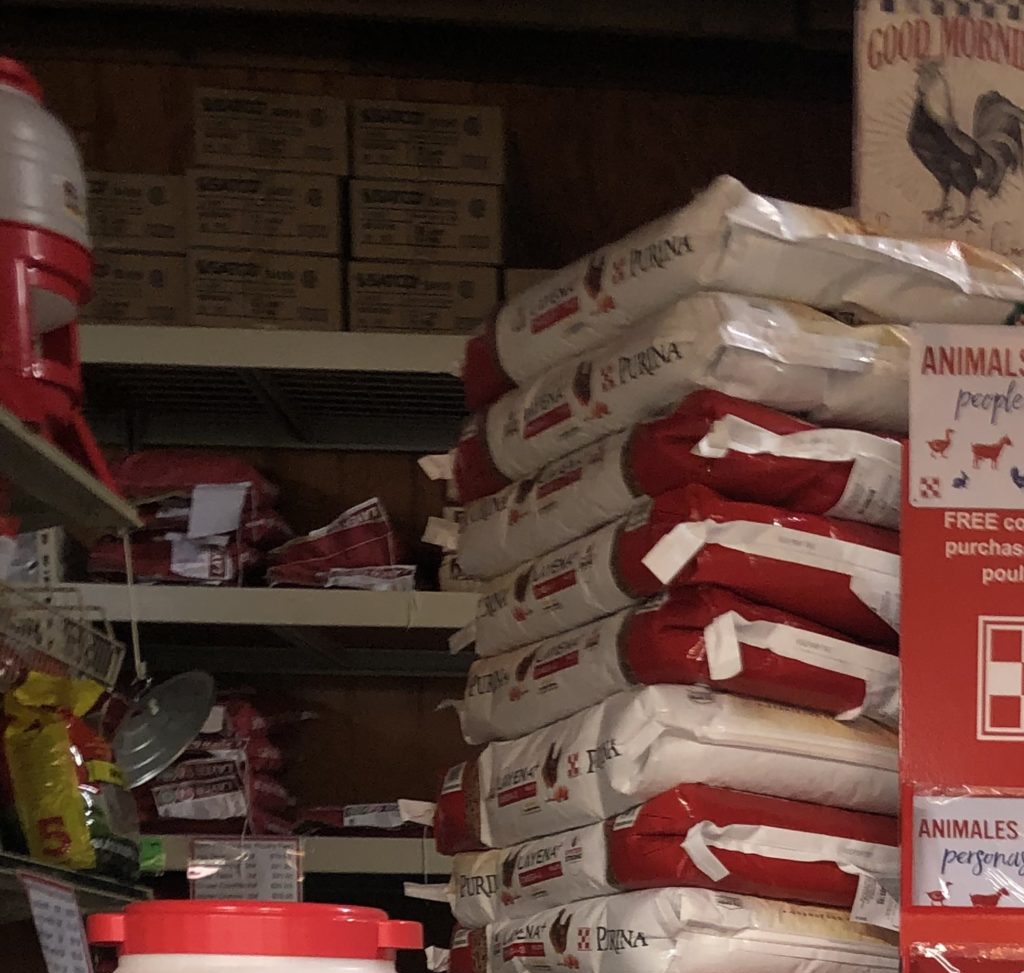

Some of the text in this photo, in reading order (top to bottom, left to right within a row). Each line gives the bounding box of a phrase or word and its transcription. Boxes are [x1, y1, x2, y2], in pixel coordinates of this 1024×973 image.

[868, 19, 930, 70] GOOD
[954, 380, 1024, 425] people
[944, 511, 998, 530] FREE
[918, 819, 1018, 840] ANIMALES
